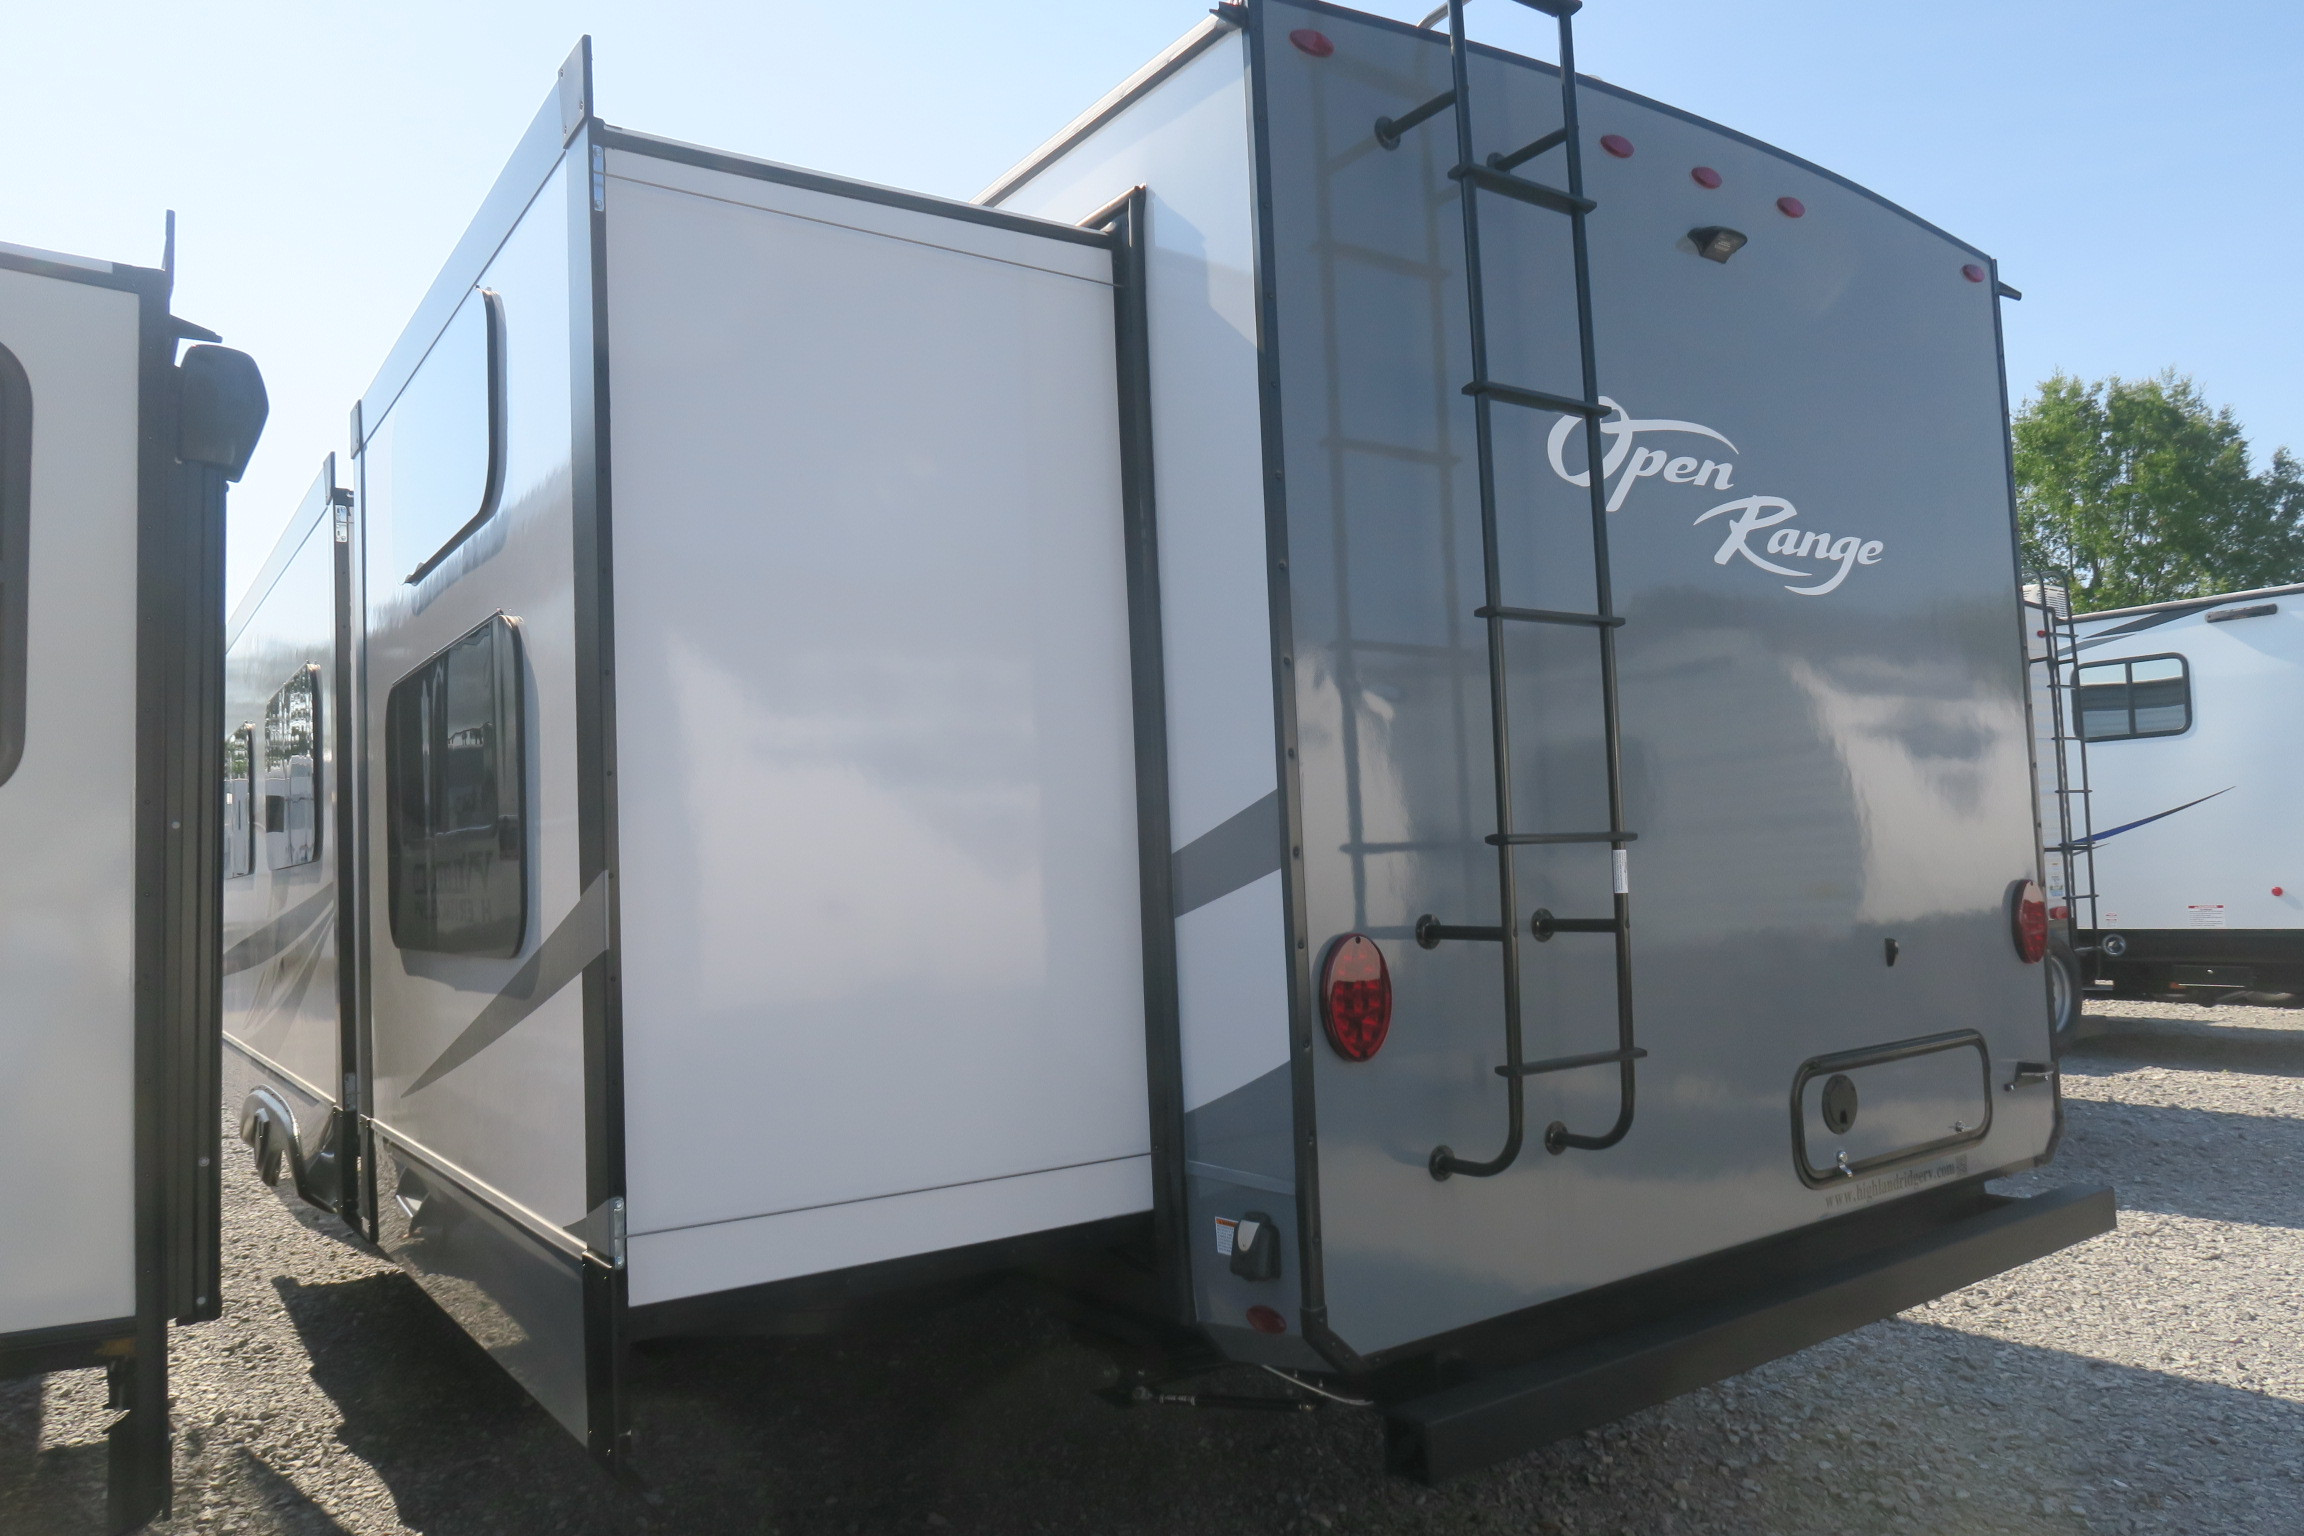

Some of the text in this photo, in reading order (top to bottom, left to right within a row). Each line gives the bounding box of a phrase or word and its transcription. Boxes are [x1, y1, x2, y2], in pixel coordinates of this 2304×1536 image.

[1547, 395, 1739, 512] Open
[1693, 494, 1884, 596] Range
[1825, 1161, 1956, 1209] www.highlandridgerv.com
